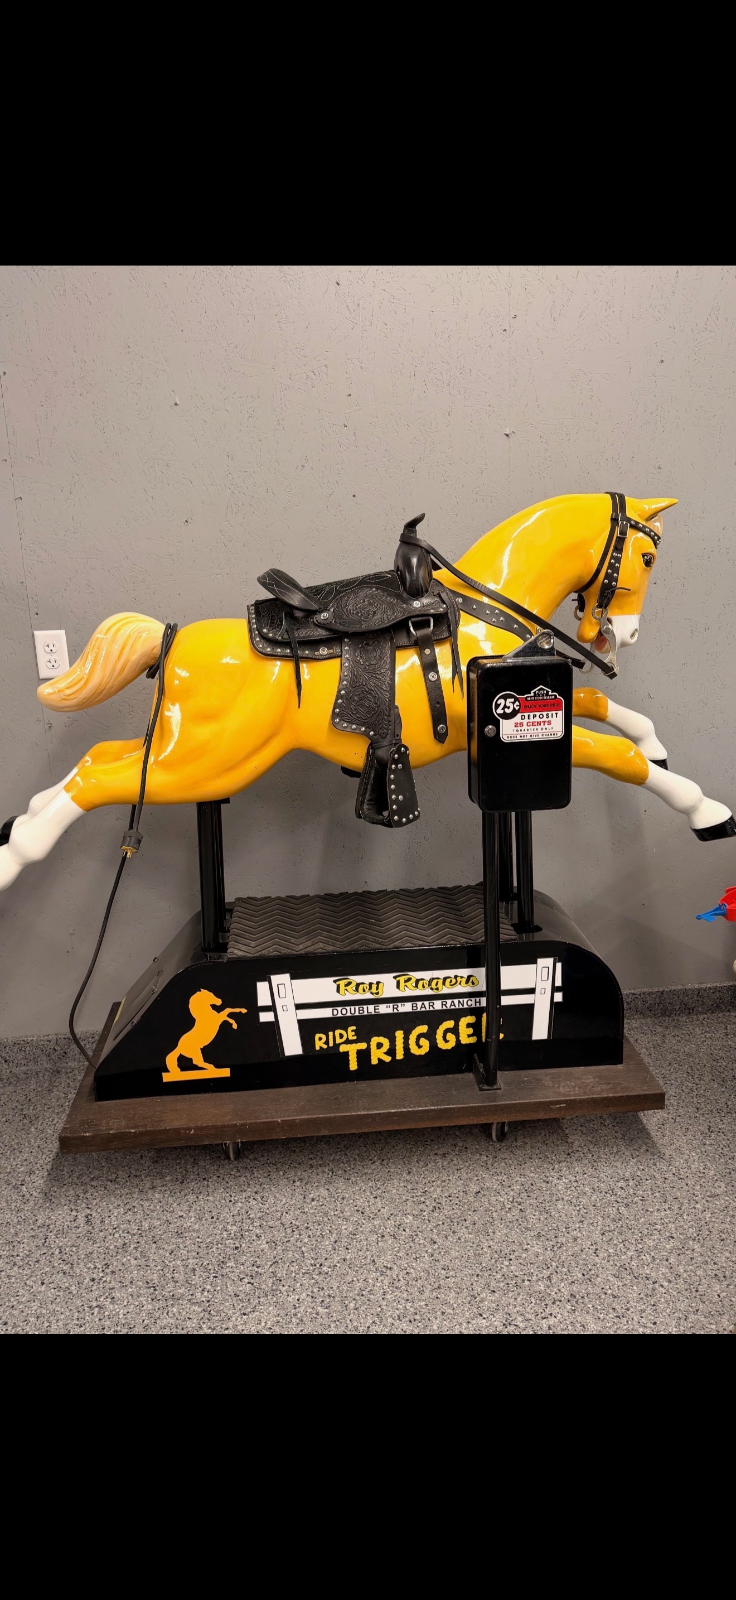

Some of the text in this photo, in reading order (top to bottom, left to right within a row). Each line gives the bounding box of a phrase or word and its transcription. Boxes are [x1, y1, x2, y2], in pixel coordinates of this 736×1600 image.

[496, 698, 520, 714] 25¢
[333, 973, 480, 997] Roy Rogers
[331, 1004, 381, 1017] DOUBLE
[411, 1001, 436, 1011] BAR
[441, 998, 482, 1008] RANCH
[314, 1026, 357, 1050] RIDE
